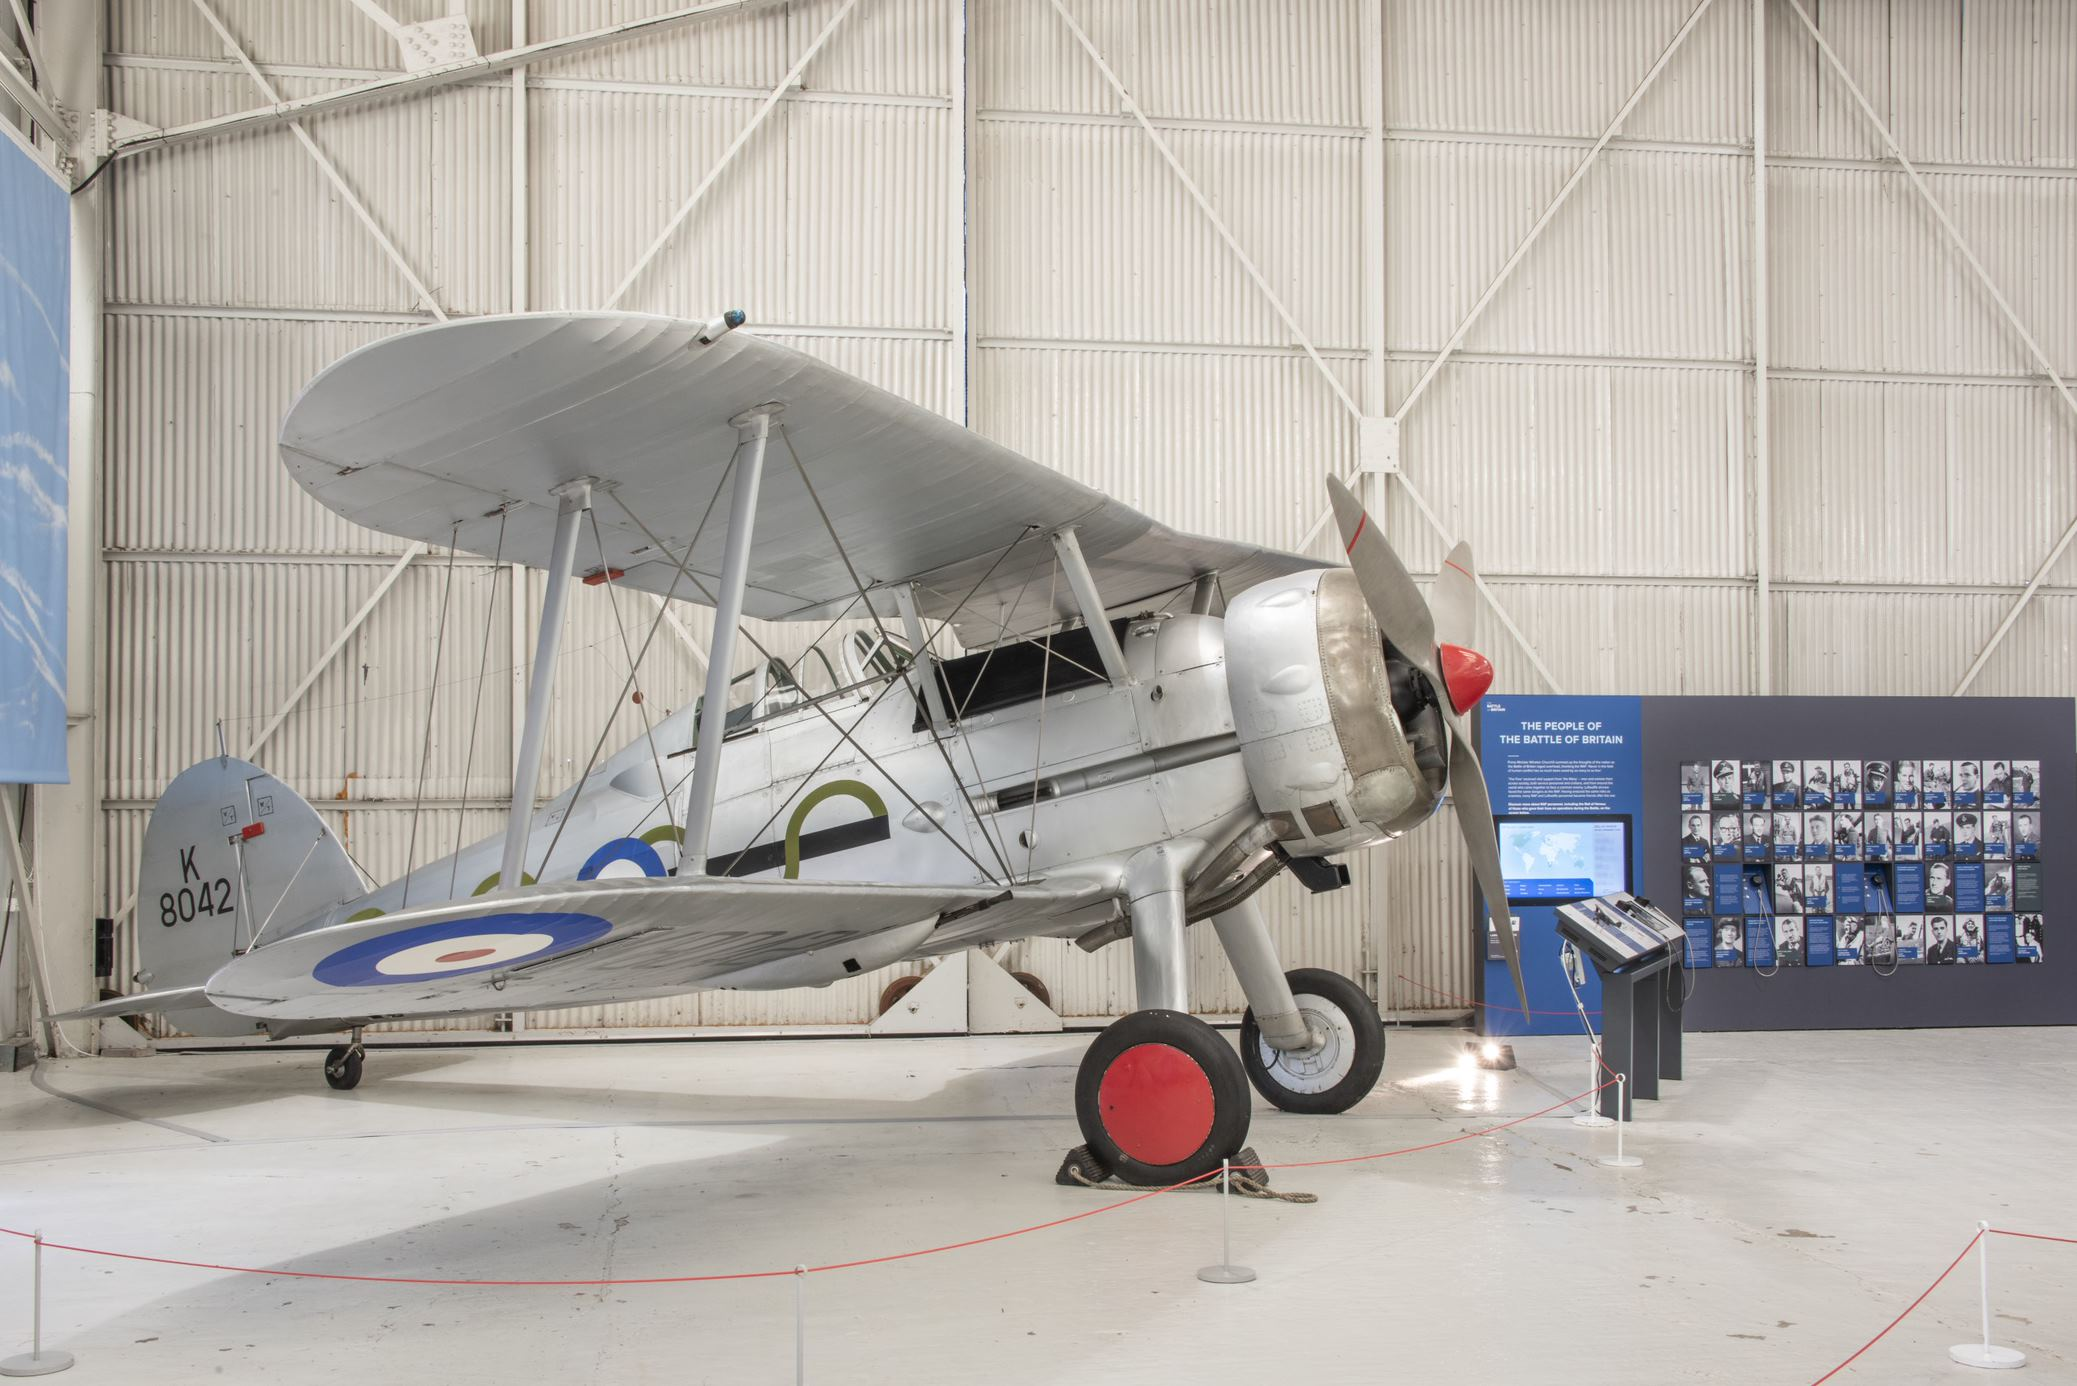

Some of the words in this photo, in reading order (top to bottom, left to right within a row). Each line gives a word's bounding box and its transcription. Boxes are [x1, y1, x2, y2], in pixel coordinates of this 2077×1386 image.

[1520, 721, 1542, 731] THE
[1544, 721, 1585, 731] PEOPLE
[1587, 721, 1602, 731] OF
[1499, 735, 1521, 744] THE
[1523, 735, 1562, 744] BATTLE
[1564, 735, 1580, 744] OF
[1582, 735, 1623, 744] BRITAIN
[180, 845, 200, 883] K
[160, 878, 234, 927] 8042
